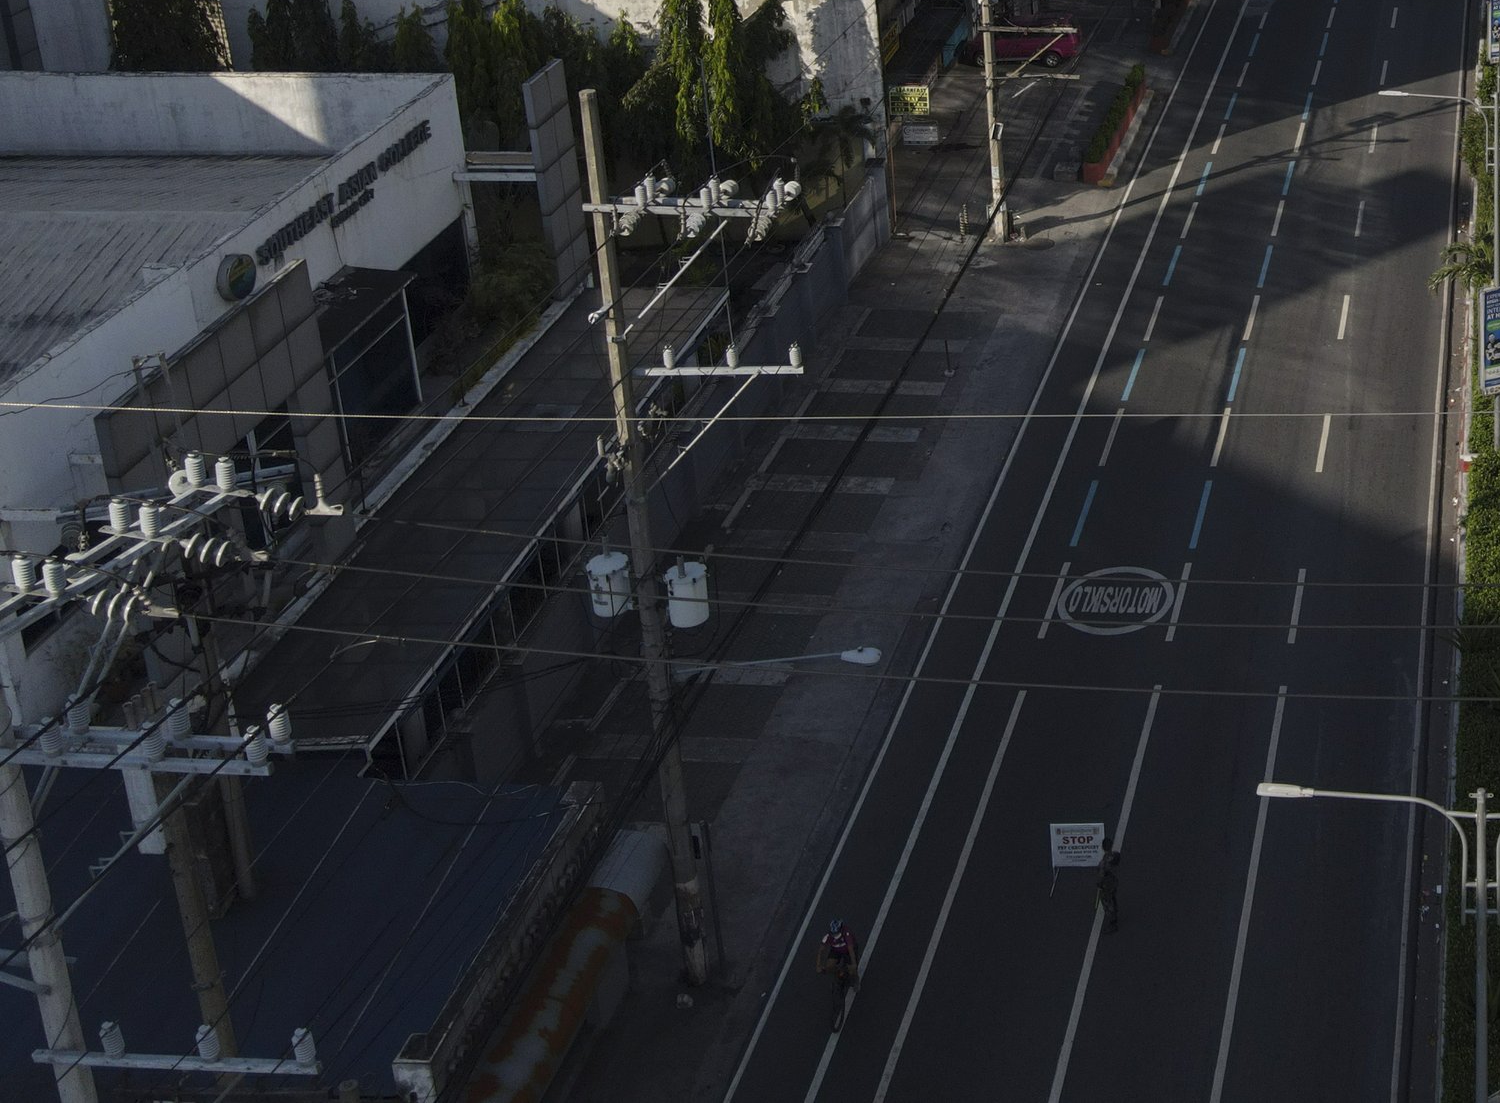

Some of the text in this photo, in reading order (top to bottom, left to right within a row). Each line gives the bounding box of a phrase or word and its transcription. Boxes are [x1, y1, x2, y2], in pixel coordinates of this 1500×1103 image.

[255, 192, 335, 266] SOUTHEAST
[338, 161, 378, 205] ASIAN
[1069, 586, 1163, 613] MOTORSIKLO
[1062, 836, 1093, 845] STOP
